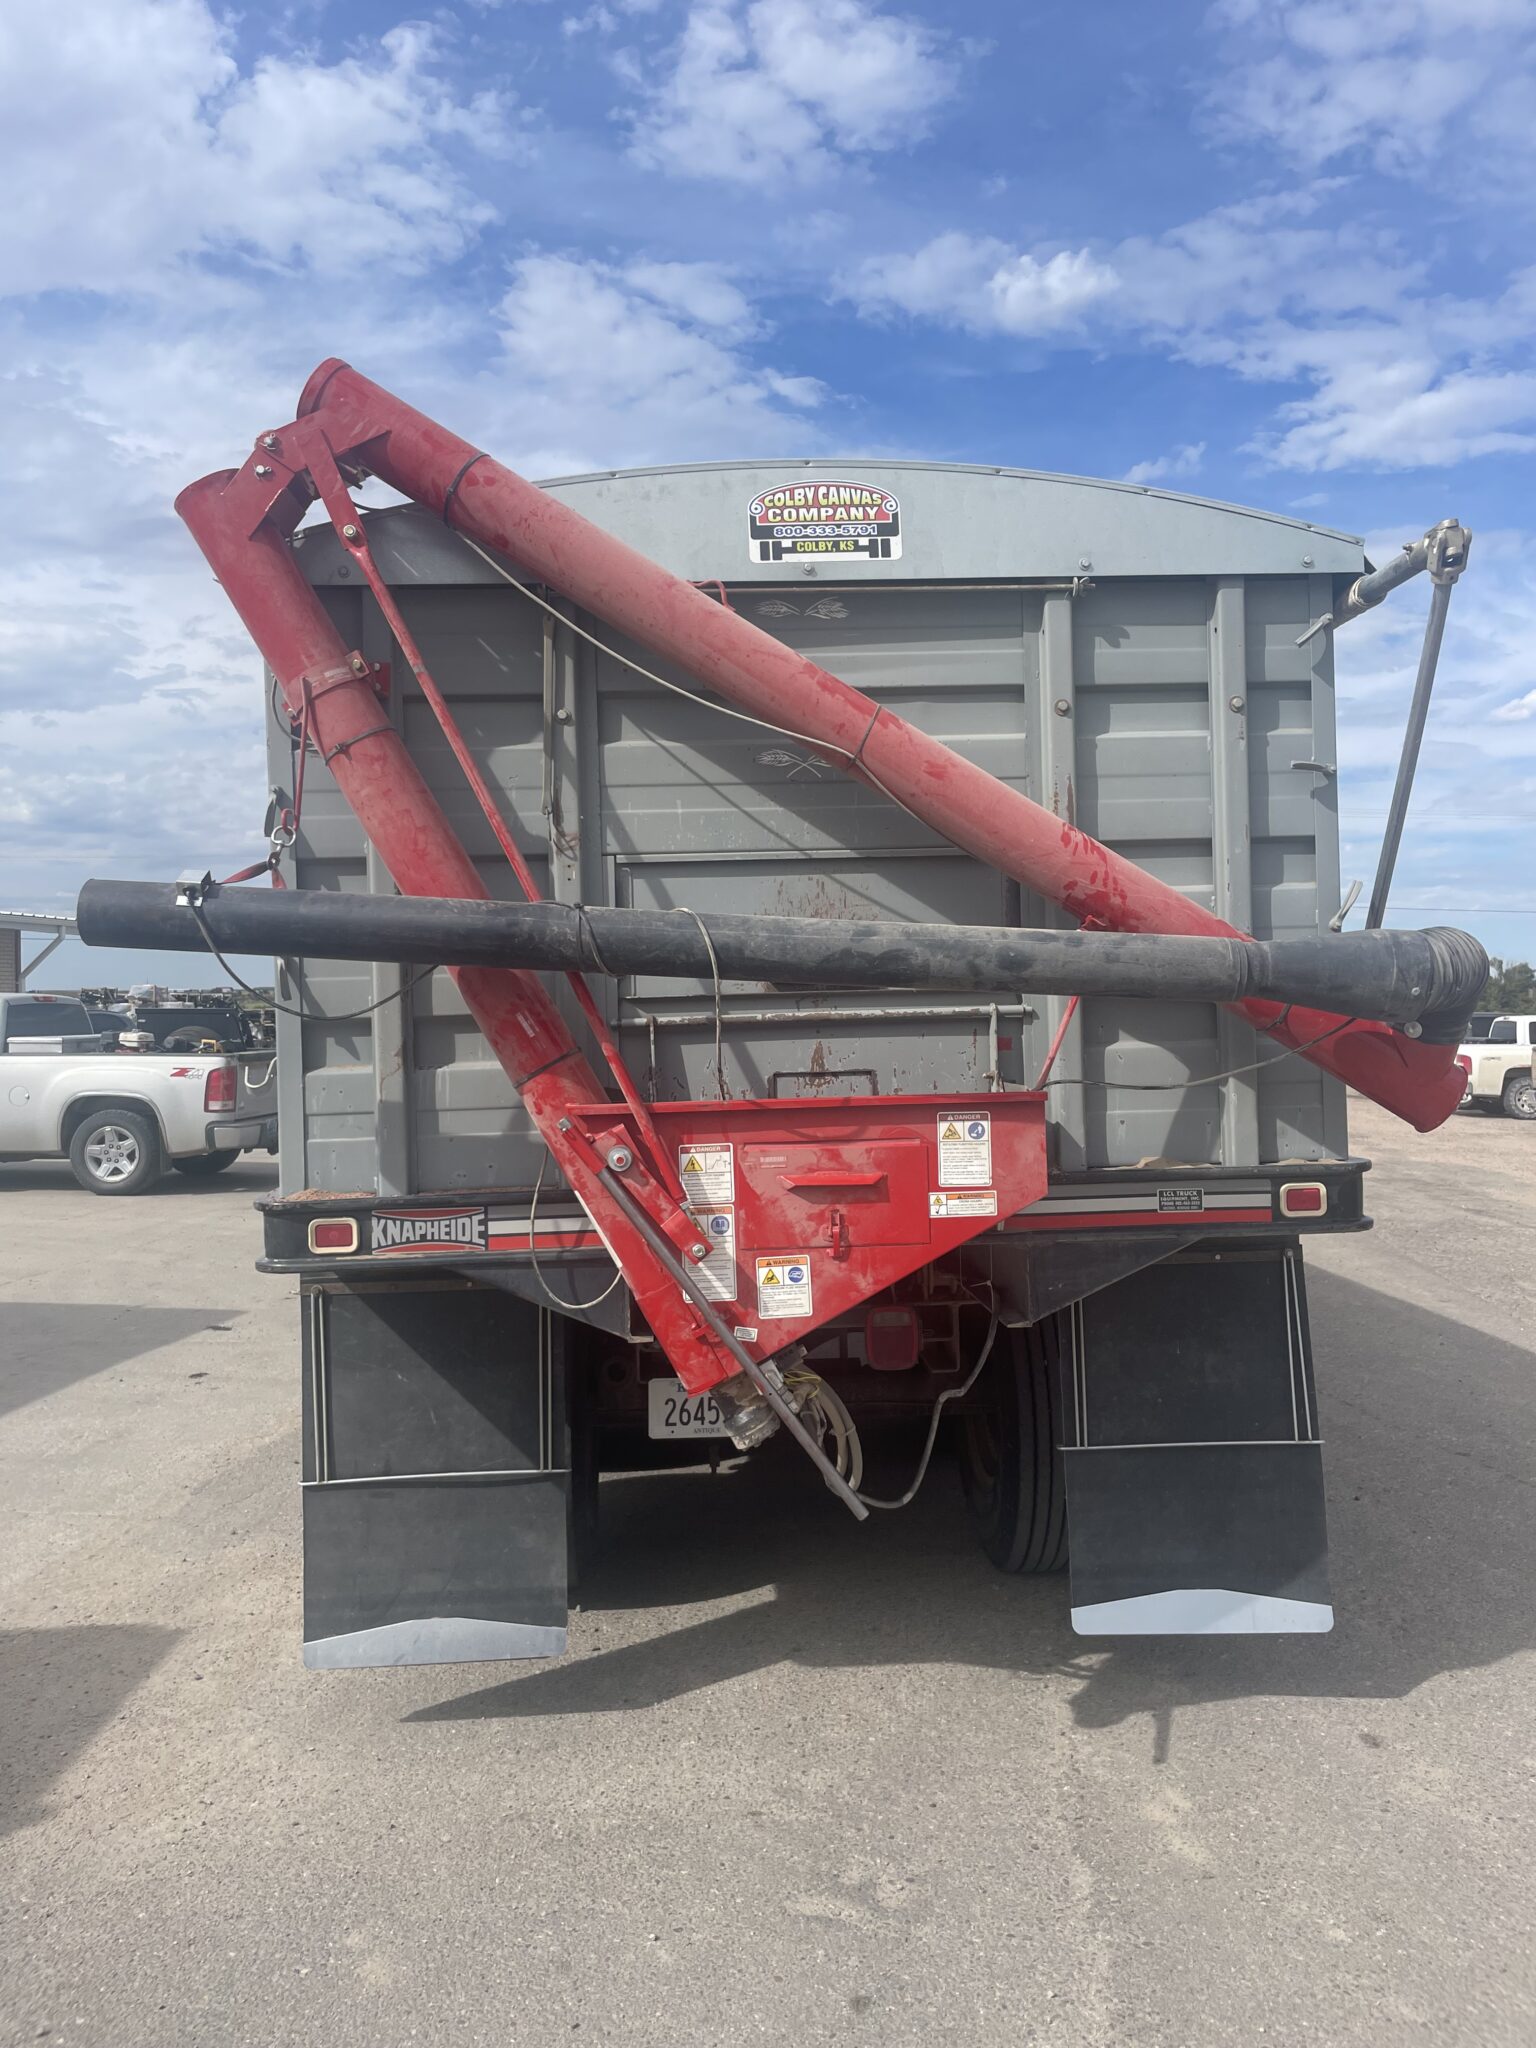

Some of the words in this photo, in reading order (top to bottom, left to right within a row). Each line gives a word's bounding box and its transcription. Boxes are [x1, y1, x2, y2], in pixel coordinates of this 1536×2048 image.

[764, 486, 815, 507] COLBY
[817, 485, 882, 506] CANVAS
[767, 506, 879, 523] COMPANY
[774, 524, 878, 537] 800-333-5791
[796, 541, 836, 553] COLBY,
[839, 540, 855, 551] KS
[371, 1213, 486, 1249] KNAPHEIDE
[664, 1396, 727, 1427] 2645
